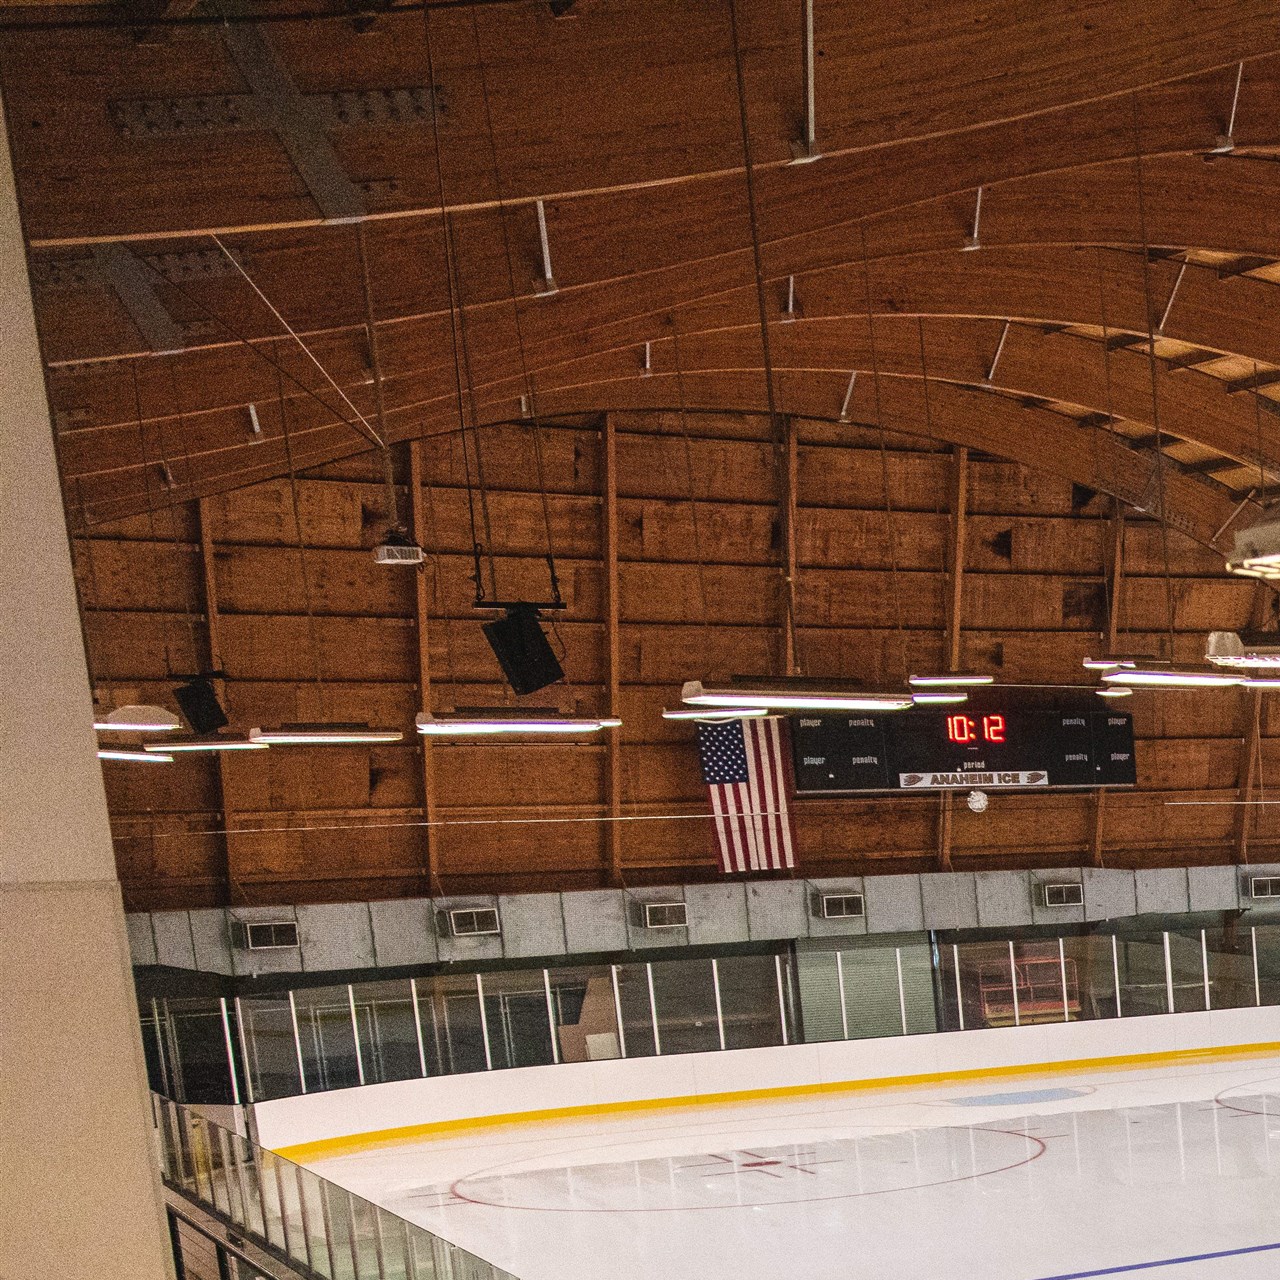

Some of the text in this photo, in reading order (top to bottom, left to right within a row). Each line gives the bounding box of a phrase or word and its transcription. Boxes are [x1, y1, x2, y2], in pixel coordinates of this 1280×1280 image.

[800, 718, 822, 728] player
[848, 718, 875, 728] penalty
[946, 715, 1006, 742] 10:12
[803, 756, 826, 766] player
[852, 755, 879, 766] penalty
[963, 760, 985, 769] period
[929, 772, 1020, 786] ANAHEIM ICE
